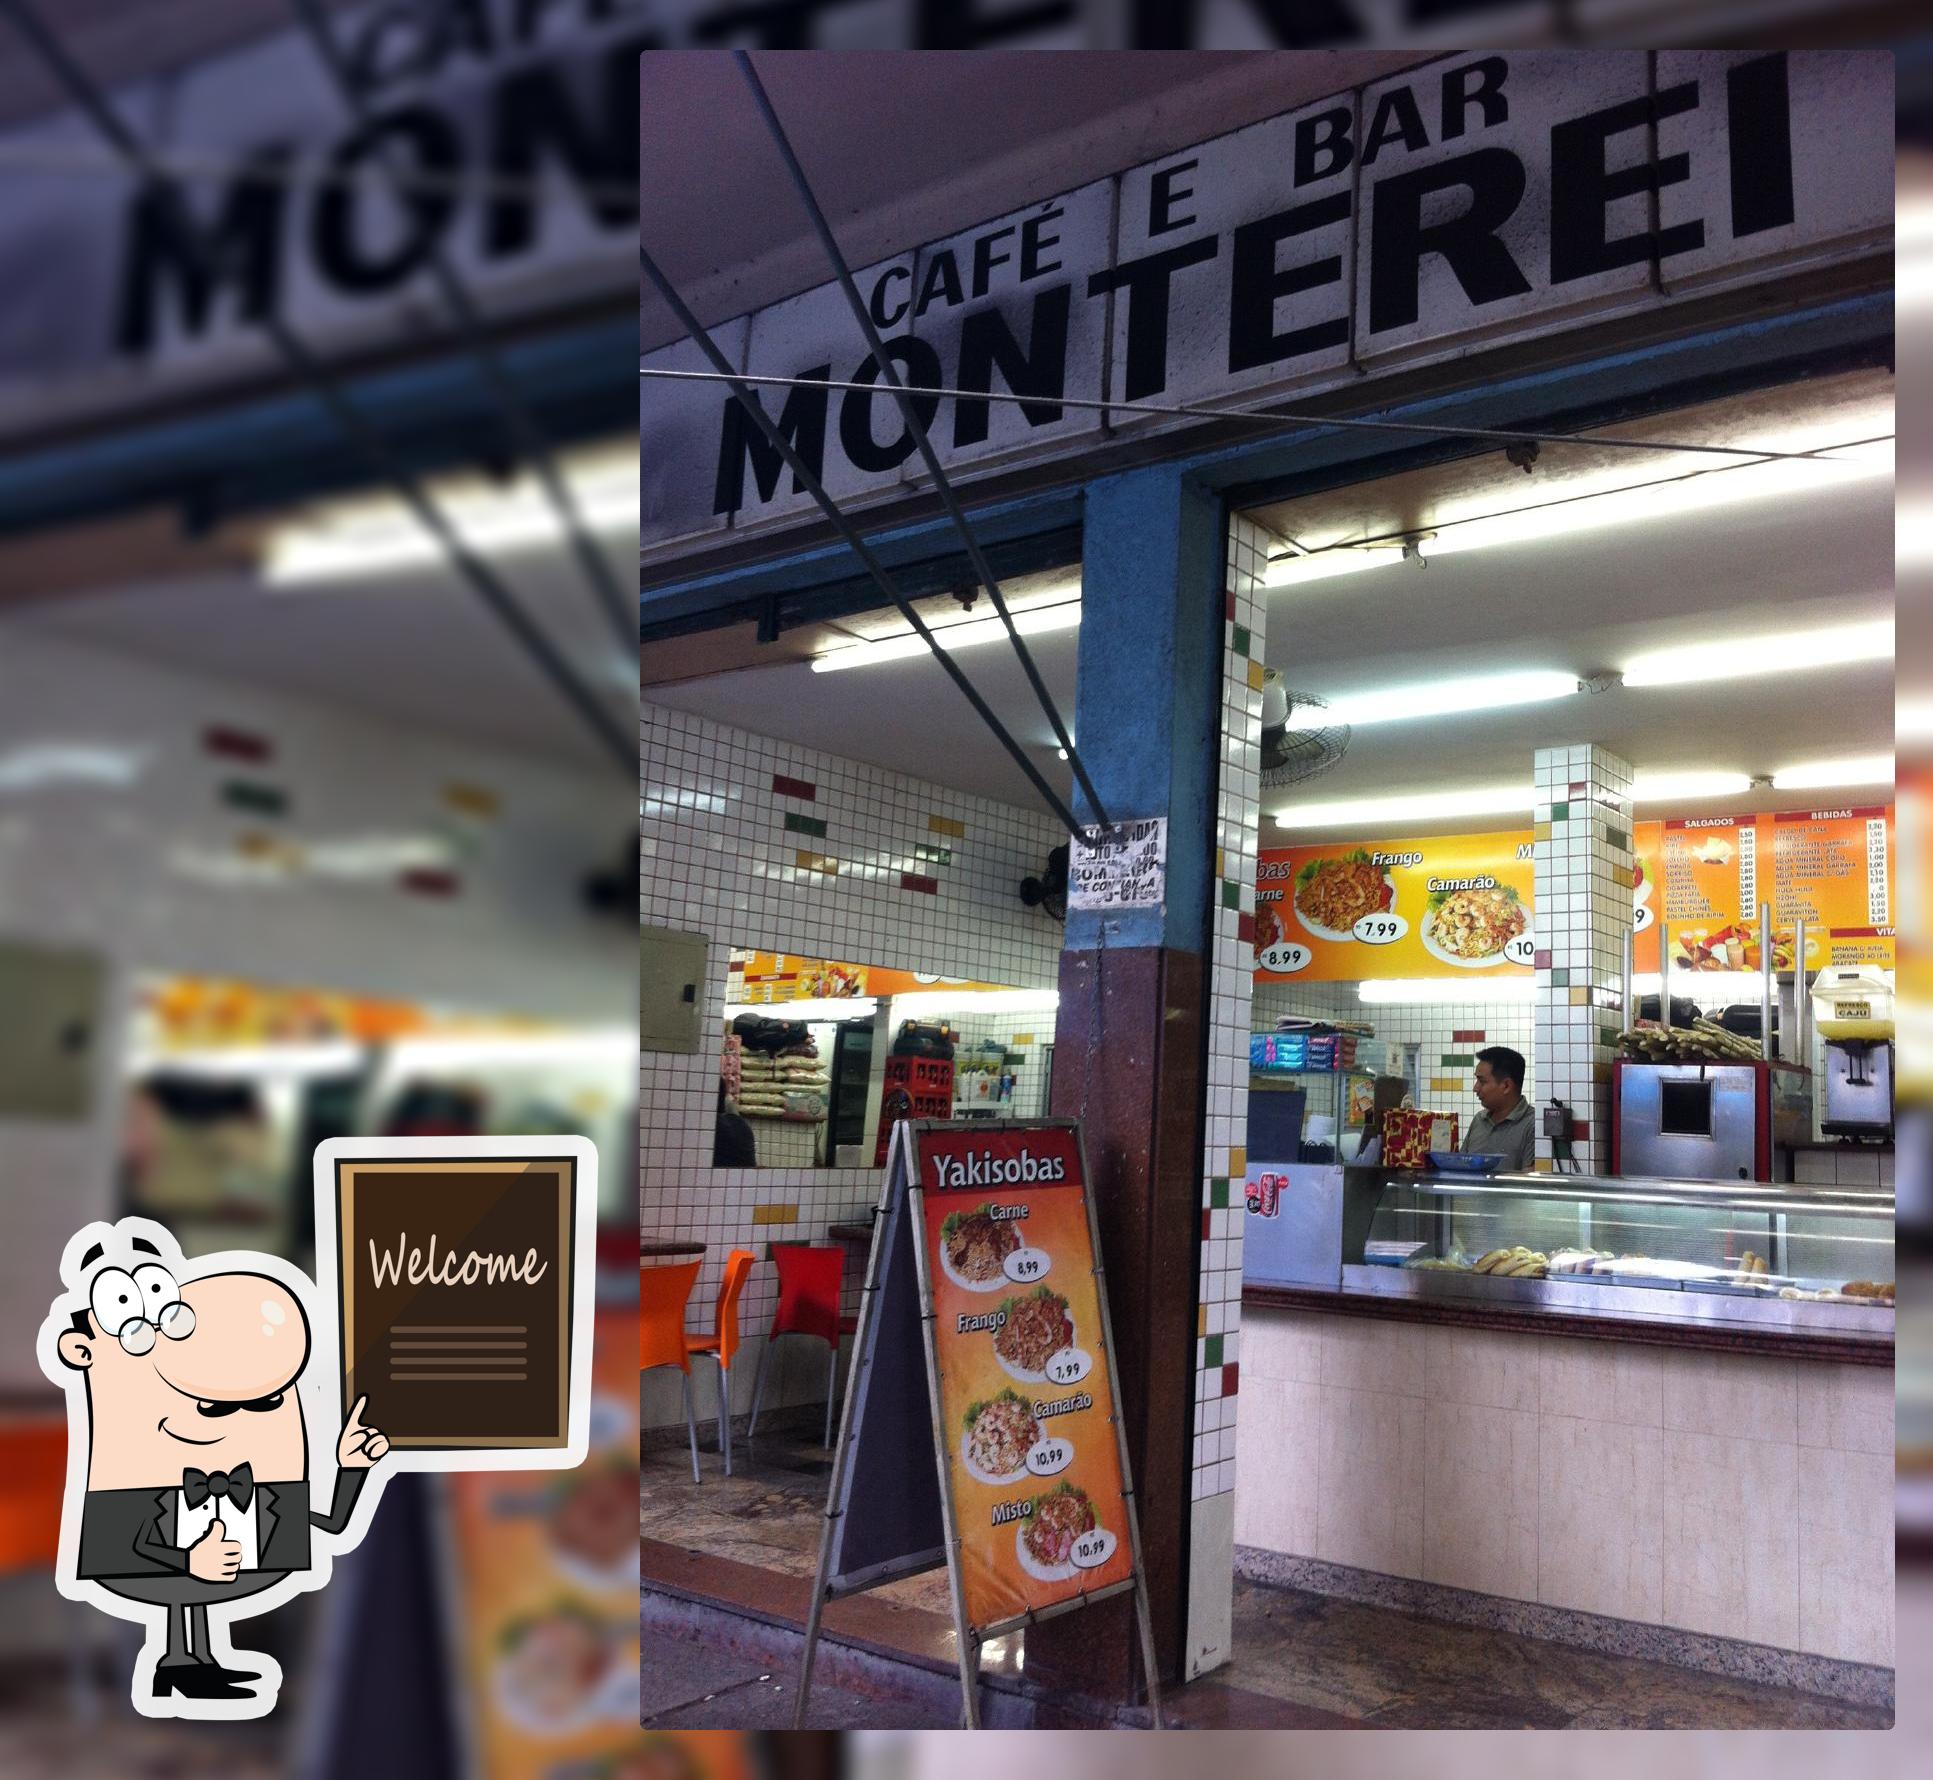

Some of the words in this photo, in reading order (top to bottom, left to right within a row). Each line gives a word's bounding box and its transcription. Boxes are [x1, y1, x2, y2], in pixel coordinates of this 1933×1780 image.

[870, 201, 1064, 328] CAFÉ
[1149, 159, 1198, 237] E
[1294, 56, 1508, 188] BAR
[713, 52, 1795, 516] MONTEREI
[1684, 817, 1735, 828] SALGADOS
[1812, 810, 1853, 820] BEBIDAS
[1371, 850, 1423, 869] Frango
[1426, 873, 1495, 893] Camarão
[1365, 922, 1397, 937] 7,99
[1269, 950, 1301, 965] 8,99
[933, 1149, 1065, 1189] Yakisobas
[989, 1203, 1030, 1221] Carne
[957, 1311, 1007, 1333] Frango
[1055, 1363, 1080, 1380] 7,99
[1033, 1393, 1093, 1419] Camarão
[1035, 1448, 1063, 1466] 10,99
[992, 1499, 1032, 1526] Misto
[1078, 1539, 1105, 1557] 10,99
